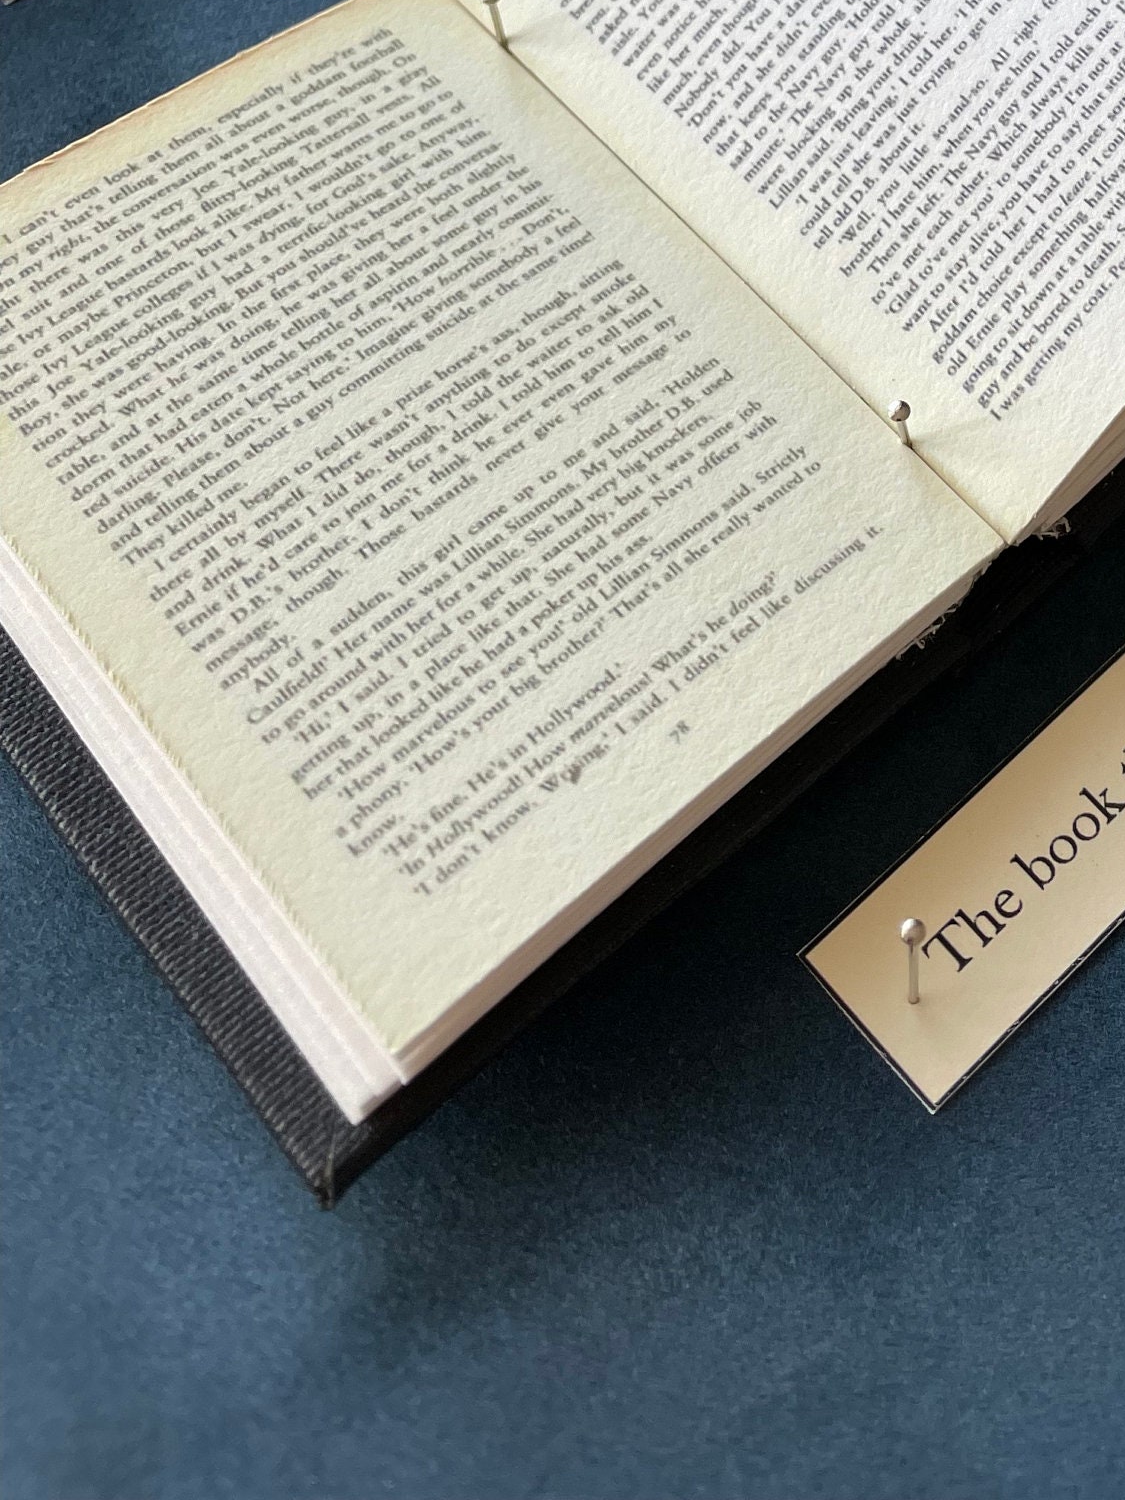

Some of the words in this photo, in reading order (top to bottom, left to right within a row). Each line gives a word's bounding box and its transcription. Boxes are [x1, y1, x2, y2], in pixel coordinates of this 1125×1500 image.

[961, 351, 998, 394] going
[991, 336, 1009, 354] to
[1005, 317, 1024, 338] sit
[1020, 279, 1056, 320] down
[1054, 264, 1069, 282] at
[1066, 254, 1078, 266] a
[1073, 220, 1105, 256] table
[976, 378, 1001, 409] guy
[999, 348, 1024, 381] and
[1017, 333, 1039, 353] be
[1031, 291, 1072, 335] bored
[1067, 277, 1085, 296] to
[1081, 239, 1121, 279] death.
[988, 407, 1002, 421] I
[999, 383, 1025, 411] was
[1022, 335, 1067, 387] getting
[1061, 312, 1084, 338] my
[1081, 281, 1113, 314] coat.
[919, 888, 1023, 973] The
